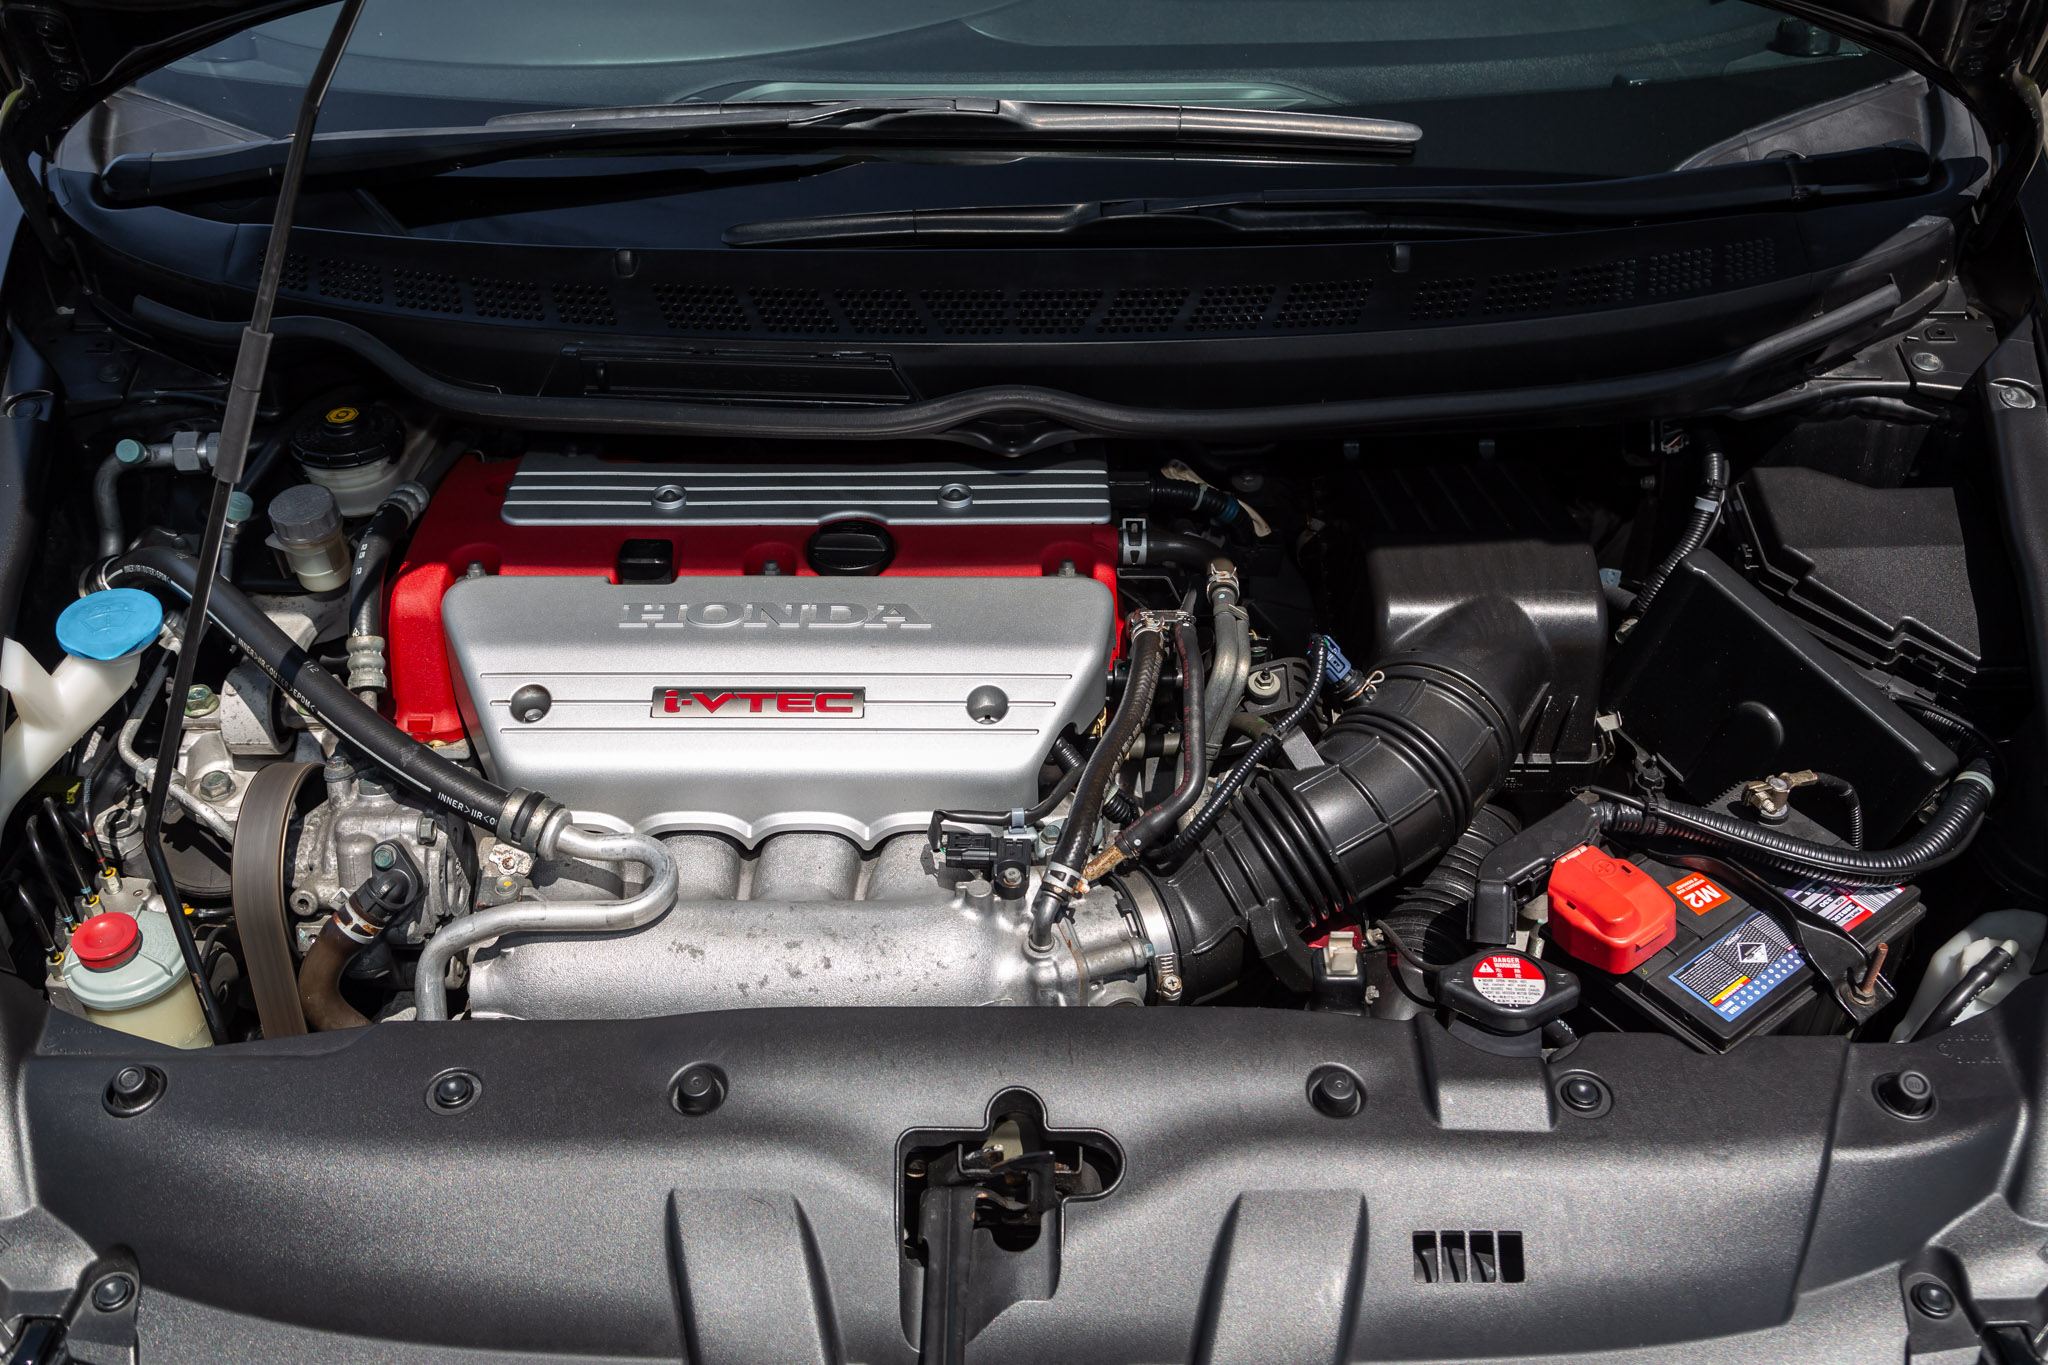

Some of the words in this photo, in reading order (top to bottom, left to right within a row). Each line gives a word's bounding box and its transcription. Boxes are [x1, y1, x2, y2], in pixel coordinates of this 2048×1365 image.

[619, 603, 932, 628] HONDA
[664, 689, 854, 713] i-VTEC
[1683, 885, 1722, 908] M2
[1818, 896, 1834, 908] 330
